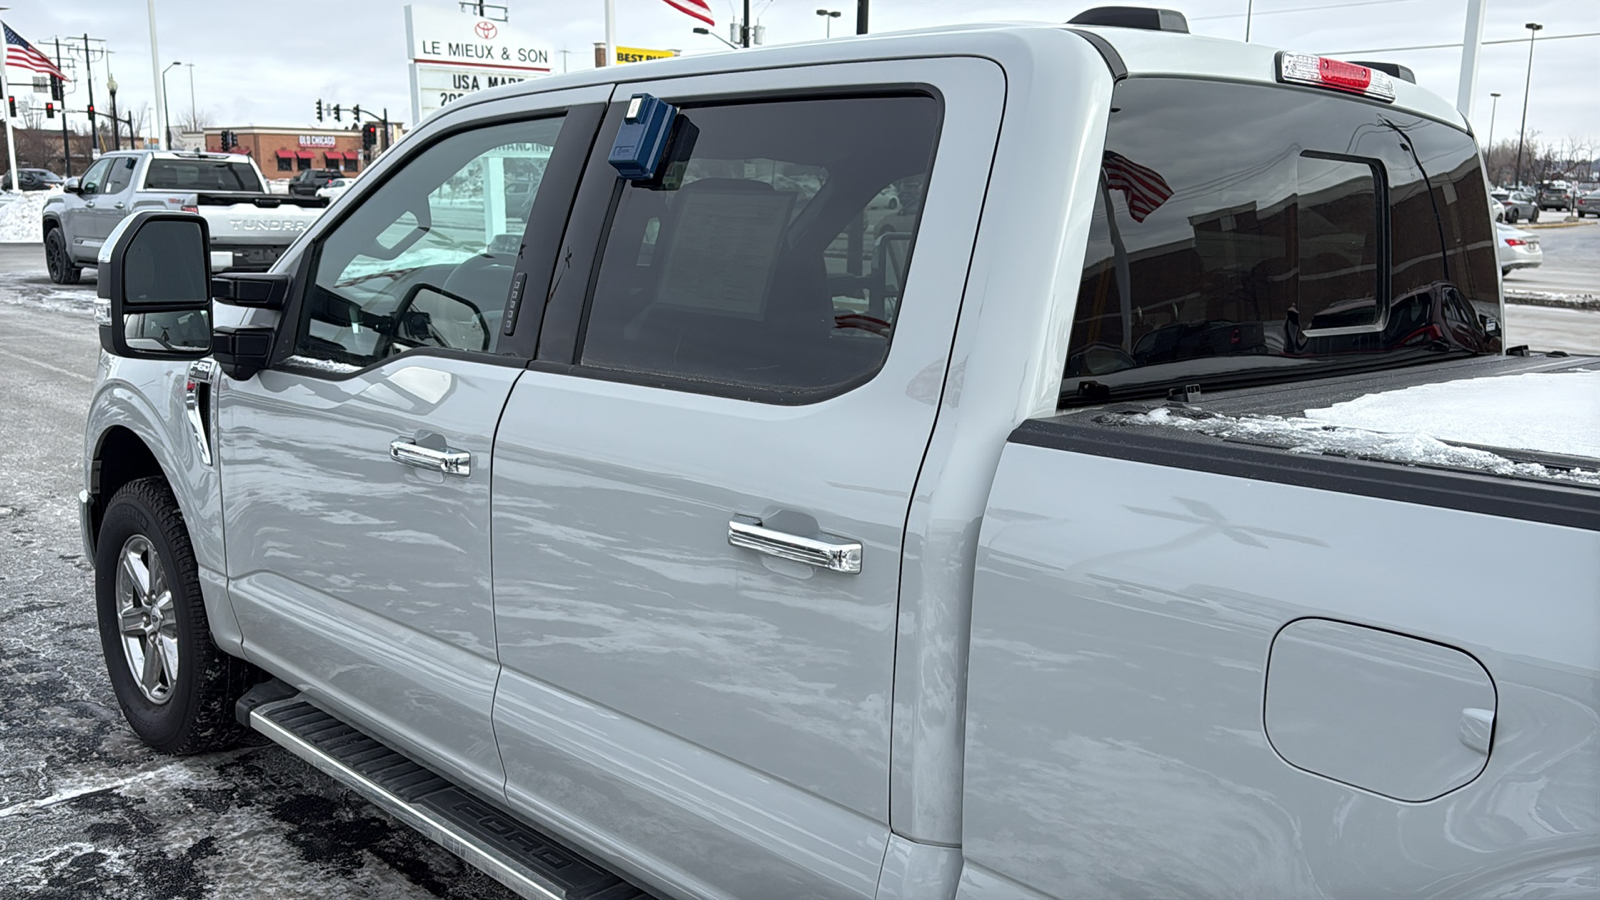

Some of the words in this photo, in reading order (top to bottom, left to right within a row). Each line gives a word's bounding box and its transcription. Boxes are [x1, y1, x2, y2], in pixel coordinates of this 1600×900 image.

[422, 40, 441, 56] LE
[448, 43, 494, 60] MIEUX
[501, 47, 511, 60] &
[518, 48, 549, 63] SON
[617, 53, 643, 62] BEST
[453, 74, 480, 90] USA
[229, 219, 307, 231] TUNDRA
[452, 802, 573, 870] FORD
